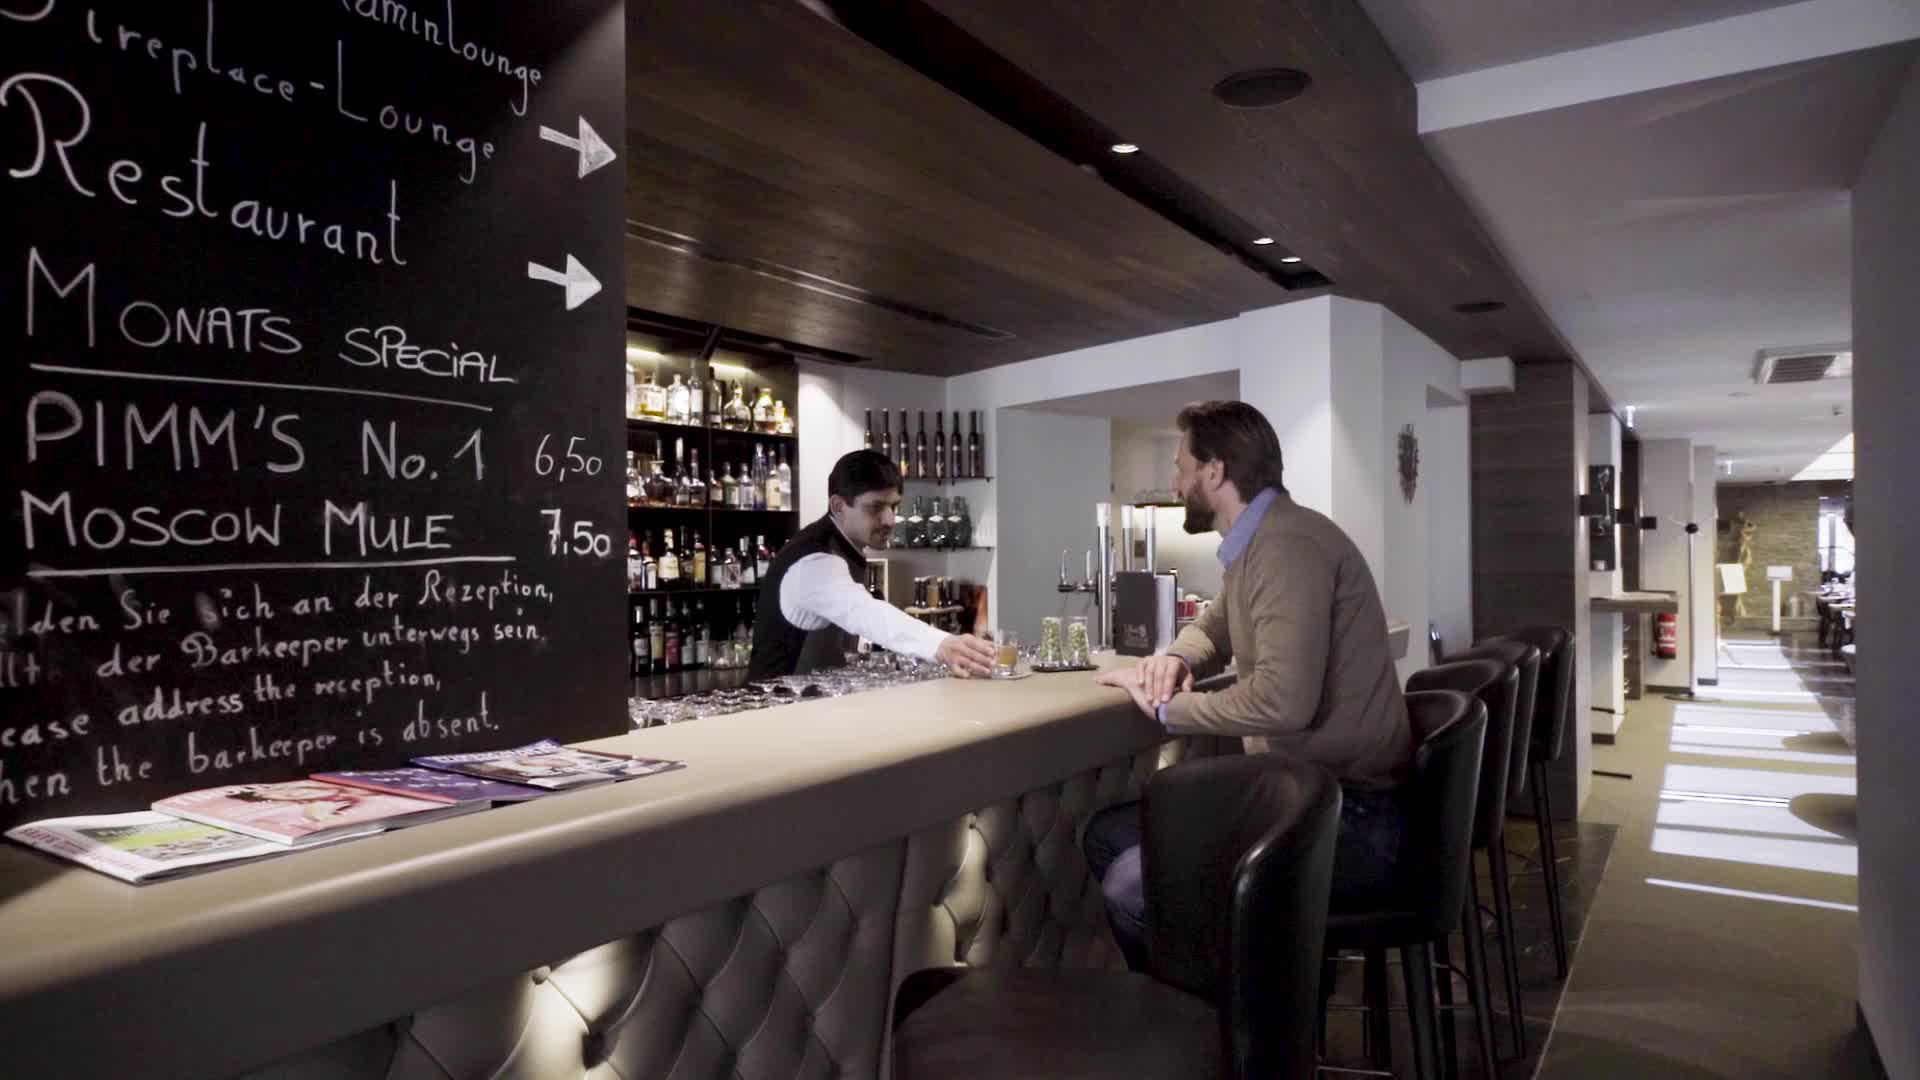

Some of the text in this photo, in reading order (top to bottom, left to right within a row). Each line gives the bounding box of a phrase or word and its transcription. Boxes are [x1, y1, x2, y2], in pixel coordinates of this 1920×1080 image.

[0, 0, 495, 184] ireplace-Lounge
[0, 73, 407, 265] Restaurant
[27, 246, 303, 354] MONATS
[26, 391, 305, 473] PIMM'S
[534, 433, 603, 483] 6,50
[20, 490, 281, 550] MOSCOW
[324, 500, 454, 556] MULE
[121, 588, 171, 631] Sie
[293, 592, 332, 616] an
[355, 576, 399, 609] der
[418, 569, 553, 611] Rezeption,
[96, 642, 161, 679] der
[180, 626, 349, 669] Barkeeper
[362, 614, 480, 654] unterwegs
[96, 744, 153, 787] the
[188, 727, 337, 775] barkeeper
[356, 709, 384, 747] is
[402, 691, 500, 743] absent.
[118, 685, 244, 728] address
[253, 673, 297, 704] the
[315, 660, 441, 703] reception,
